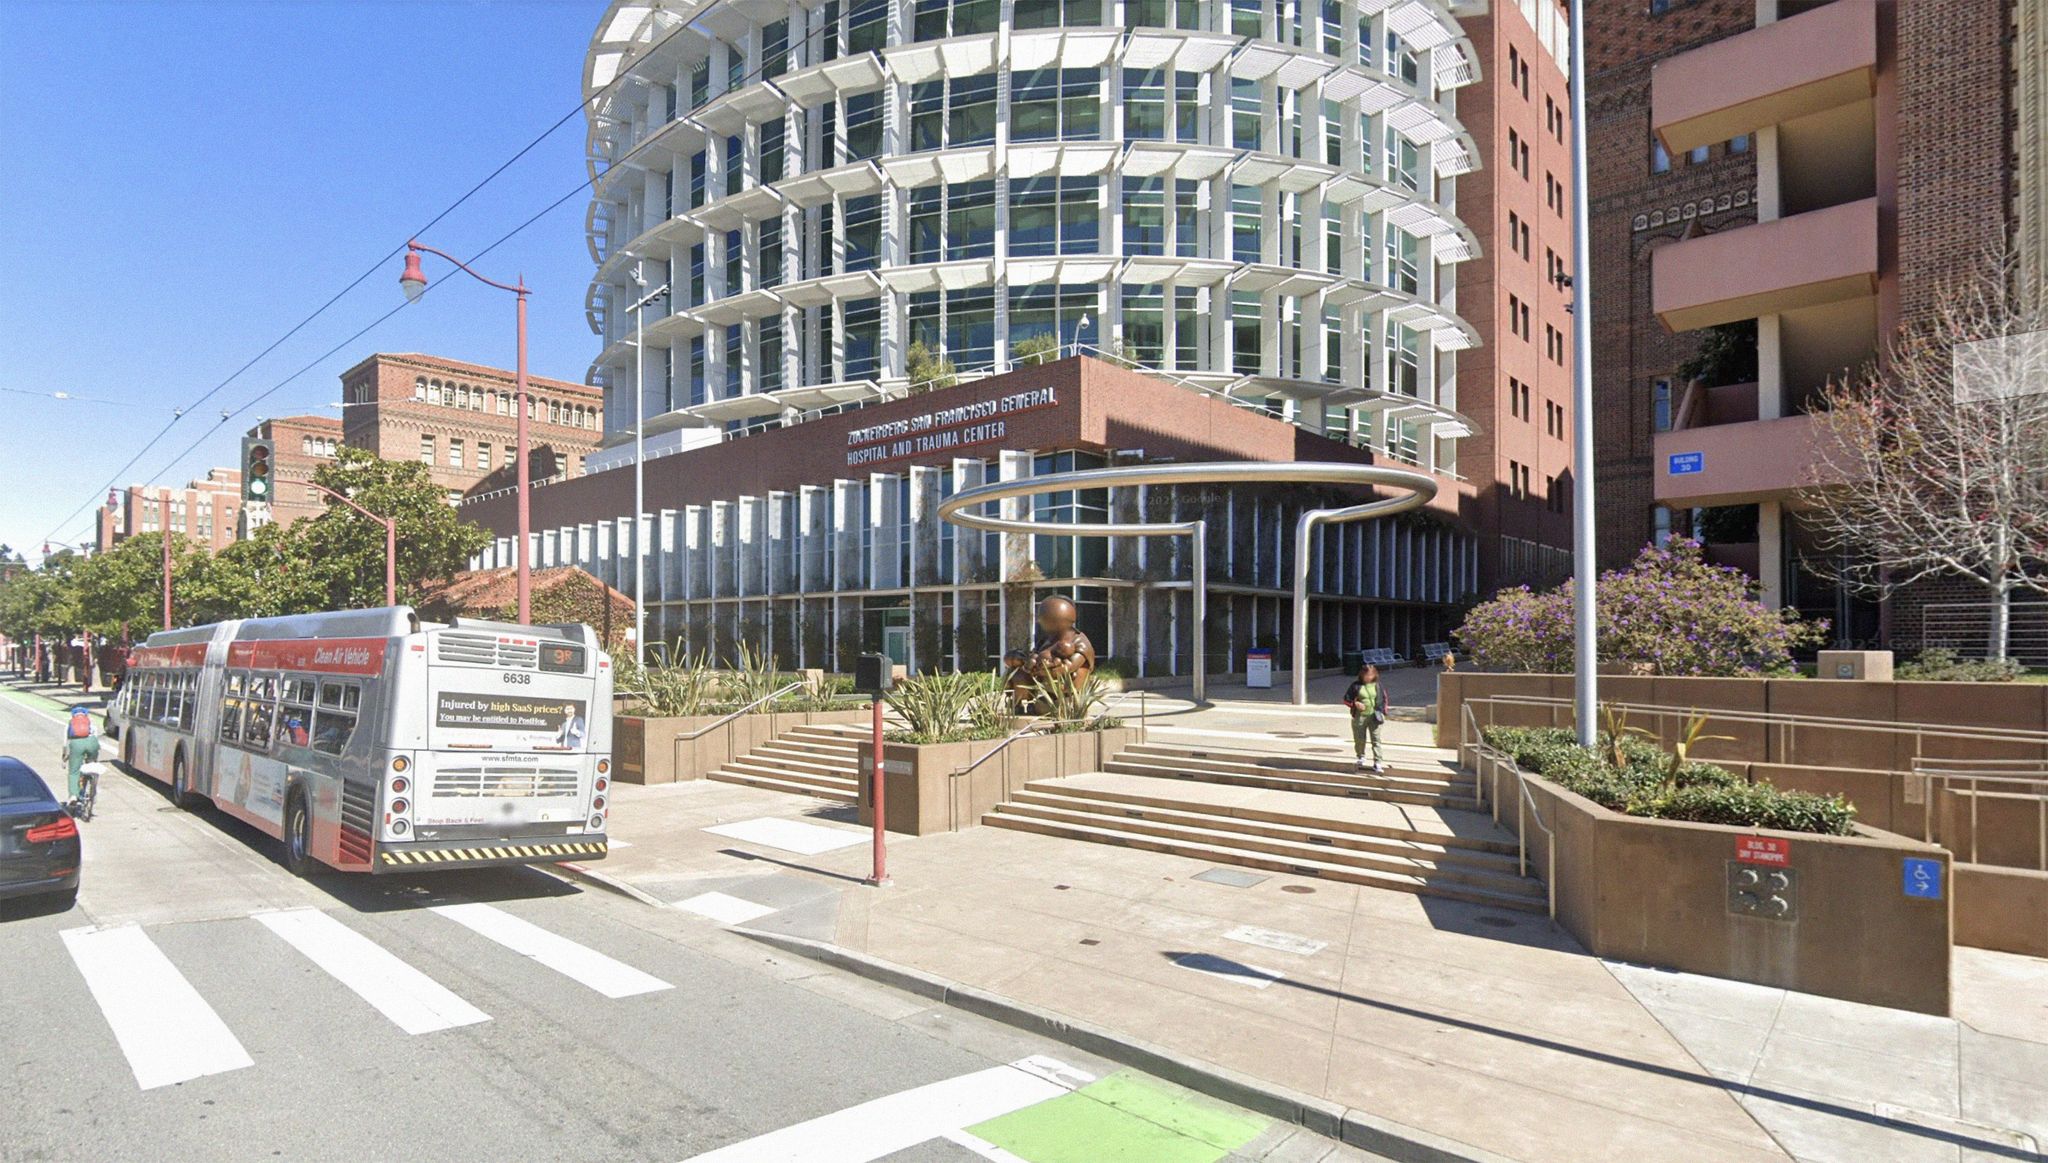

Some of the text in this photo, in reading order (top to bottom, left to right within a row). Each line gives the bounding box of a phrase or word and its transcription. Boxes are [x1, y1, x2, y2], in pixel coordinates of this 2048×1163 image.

[848, 387, 1057, 445] ZUCKERBERG SAN FRANCISCO GENERAL
[847, 421, 1005, 466] HOSPITAL AND TRAUMA CENTER
[1673, 455, 1699, 464] BUILDING
[1680, 463, 1692, 472] 30
[314, 647, 333, 664] Clean
[332, 647, 344, 664] Air
[343, 647, 370, 666] Vehicle
[554, 648, 573, 665] 9R
[502, 673, 531, 685] 6638
[440, 699, 564, 715] Injured by high SaaS prices?
[439, 712, 455, 721] You
[455, 715, 471, 723] may
[472, 714, 481, 722] be
[482, 715, 509, 724] entitled
[509, 716, 517, 724] to
[481, 754, 539, 763] www.sfmta.com
